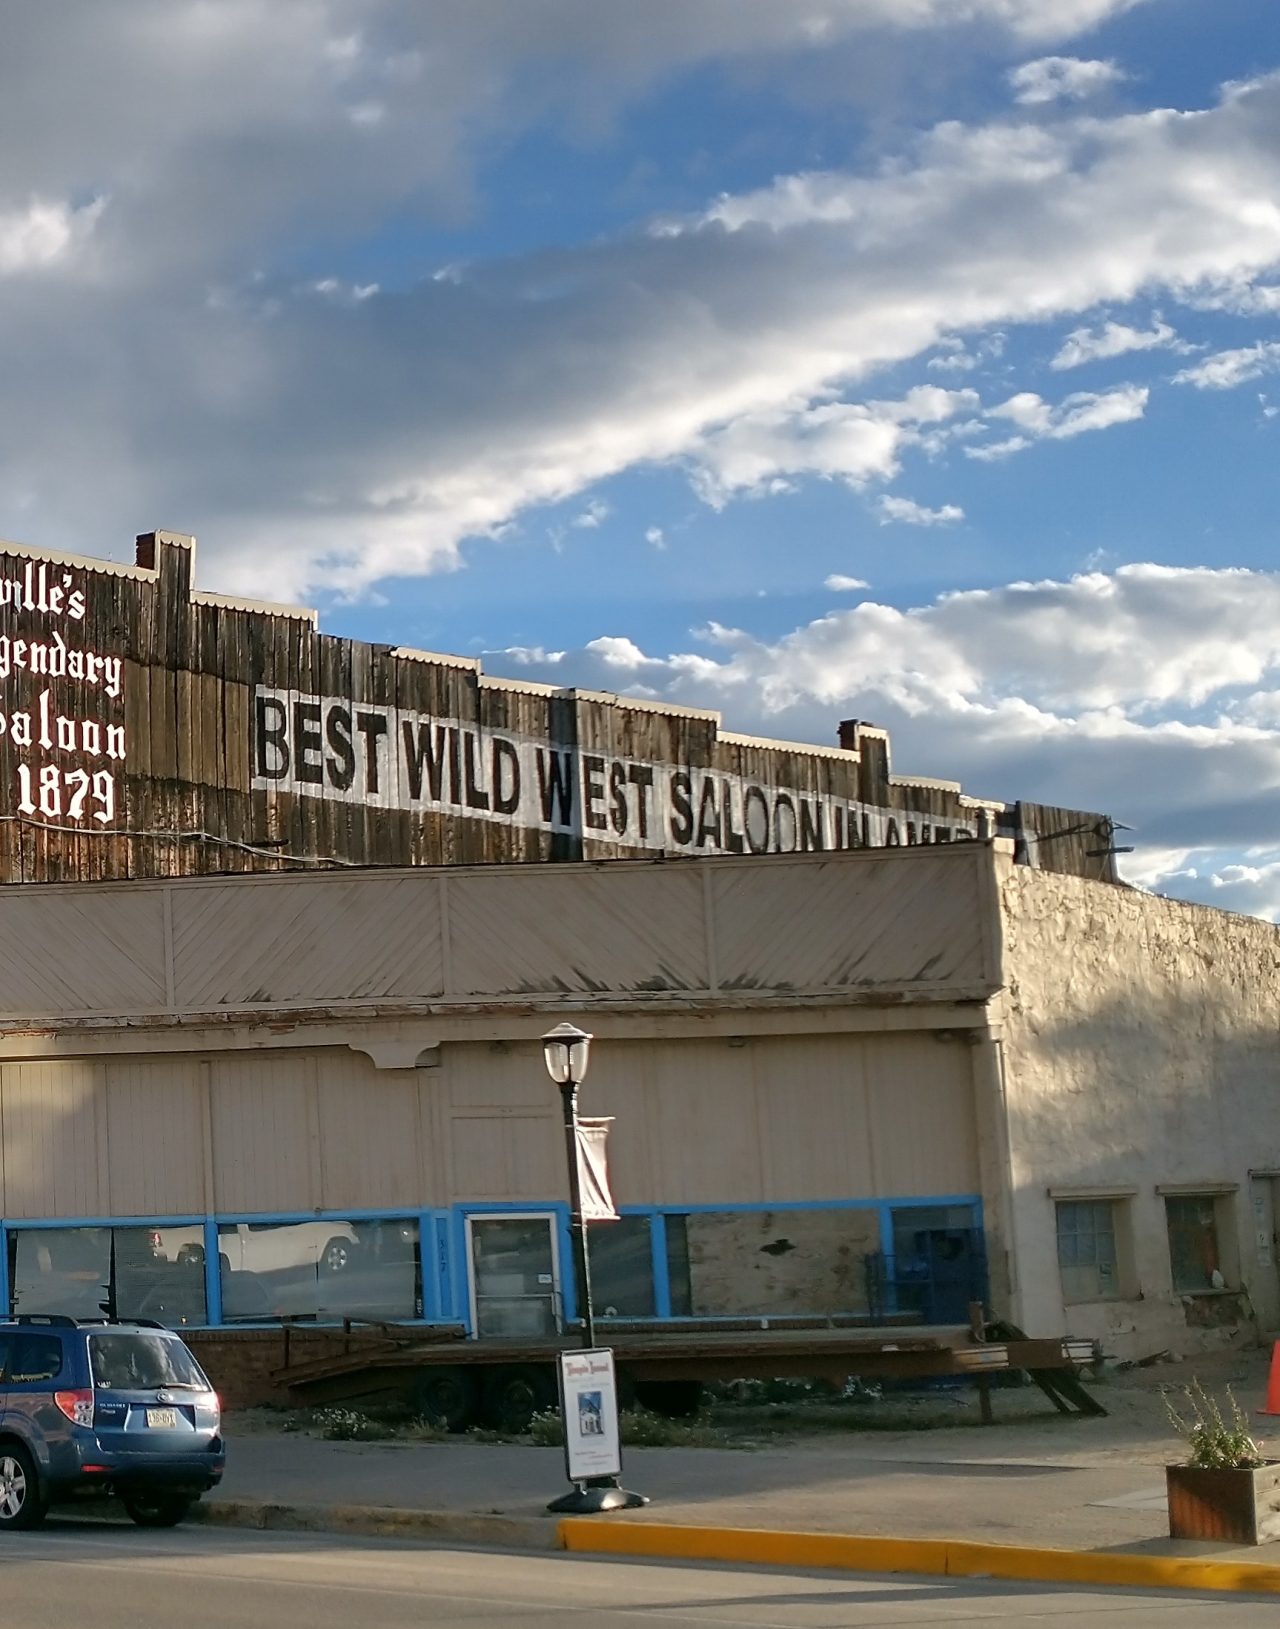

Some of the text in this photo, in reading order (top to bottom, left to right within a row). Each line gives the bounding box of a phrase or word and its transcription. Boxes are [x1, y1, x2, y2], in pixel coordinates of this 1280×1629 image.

[17, 763, 115, 824] 1879
[257, 697, 387, 793] BEST
[402, 720, 520, 815] WILD
[536, 748, 653, 839] WEST
[670, 771, 822, 851] SALOON
